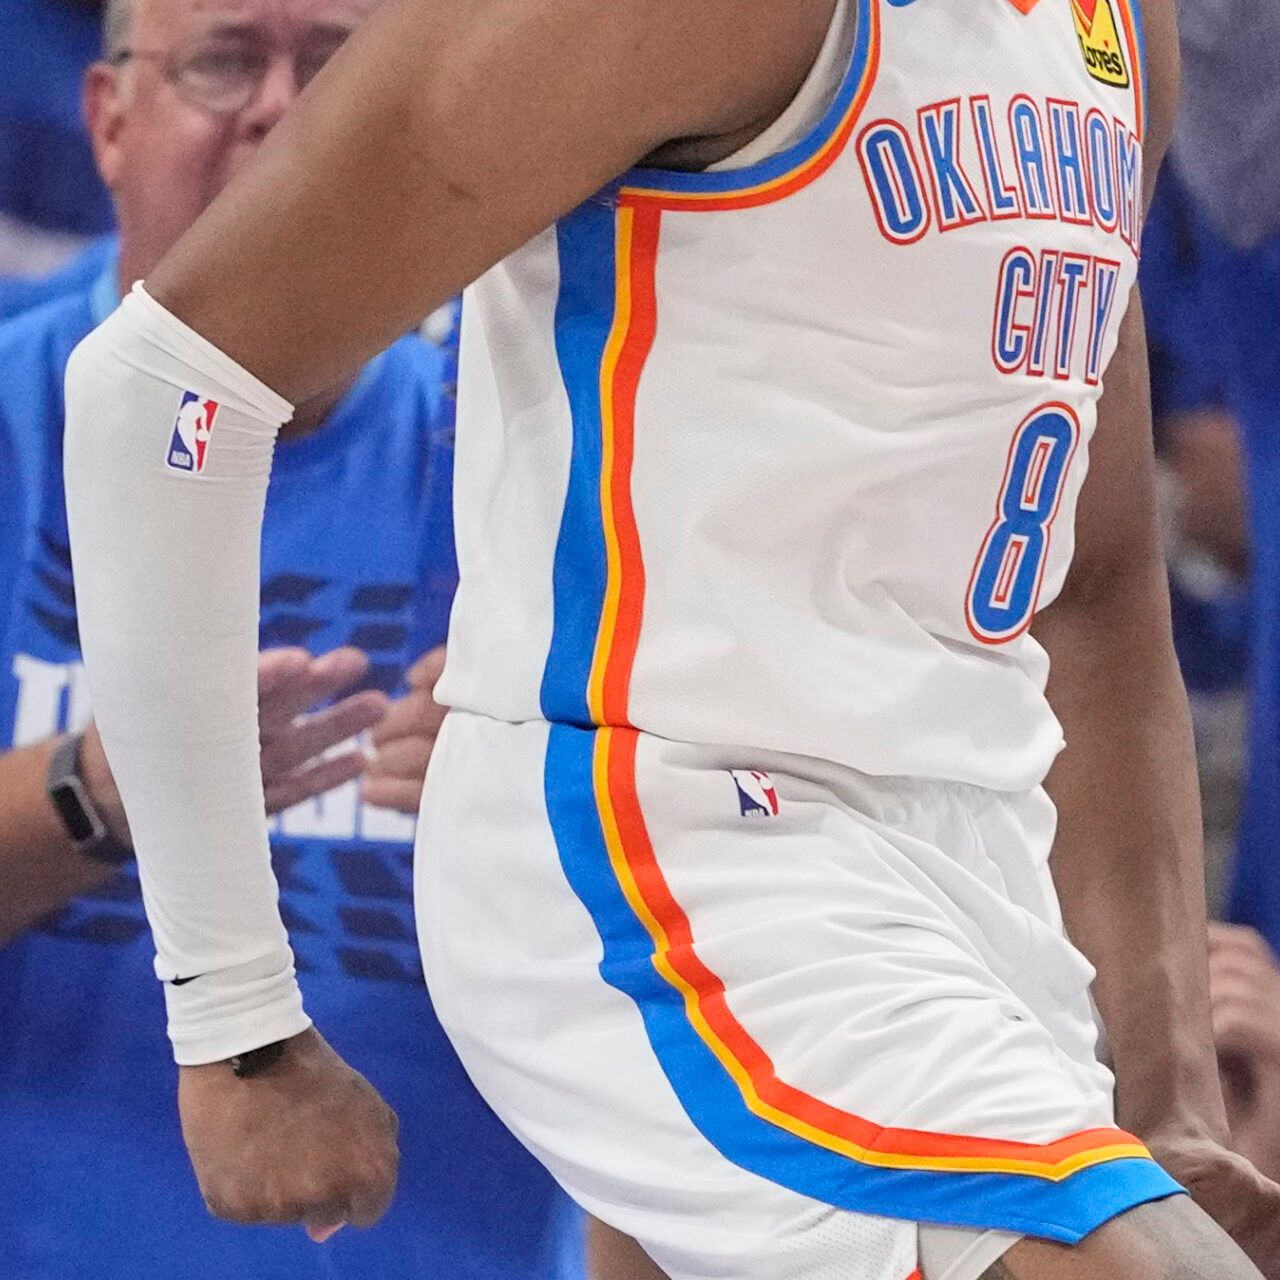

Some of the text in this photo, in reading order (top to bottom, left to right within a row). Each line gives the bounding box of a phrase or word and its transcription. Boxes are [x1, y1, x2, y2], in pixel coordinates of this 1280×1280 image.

[856, 94, 1142, 260] OKLAHOM
[992, 246, 1121, 385] CITY
[964, 400, 1081, 646] 8
